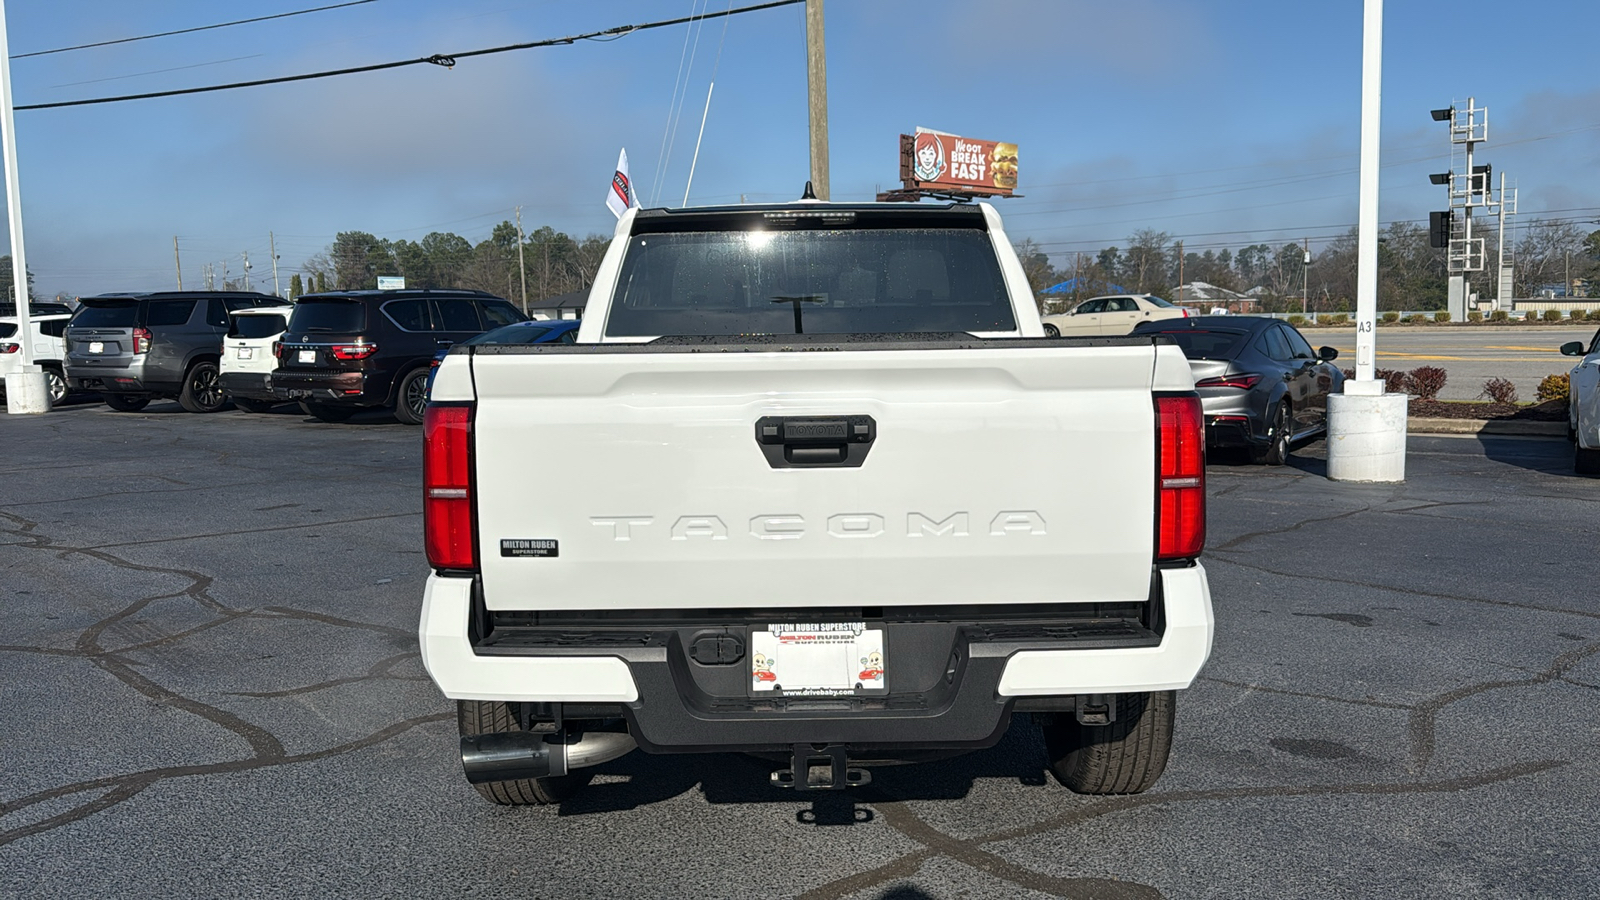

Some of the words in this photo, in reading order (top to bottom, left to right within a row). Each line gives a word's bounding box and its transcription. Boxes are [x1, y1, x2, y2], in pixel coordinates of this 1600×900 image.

[955, 139, 966, 152] We
[966, 144, 982, 153] GOT
[951, 151, 986, 165] BREAK
[951, 162, 986, 180] FAST
[1358, 321, 1372, 333] A3
[787, 425, 845, 436] TOYOTA
[589, 510, 1047, 541] TACOMA
[502, 540, 530, 549] MILTON
[531, 540, 556, 549] RUBEN
[768, 623, 795, 632] MILTON
[796, 623, 819, 632] RUBEN
[820, 622, 867, 631] SUPERSTORE
[782, 689, 855, 697] www.drivebaby.com
